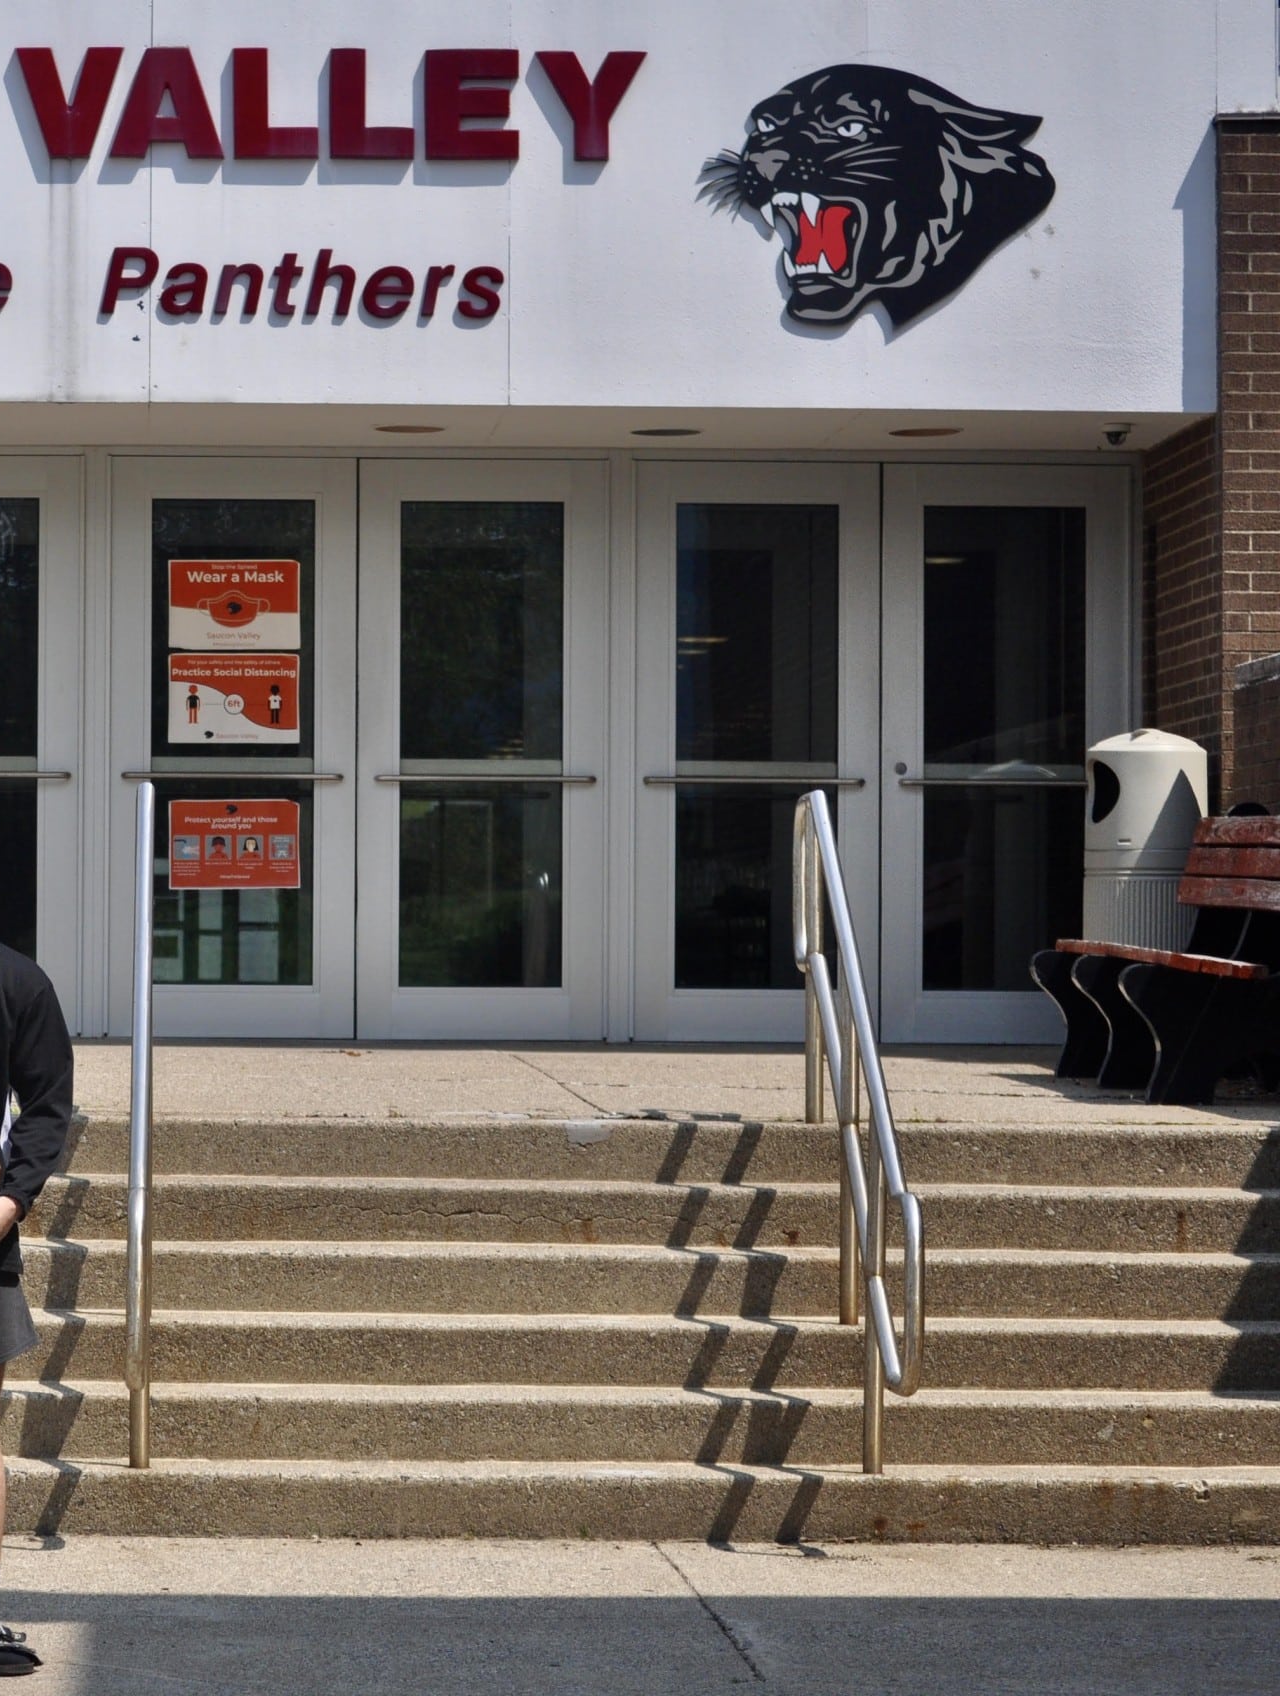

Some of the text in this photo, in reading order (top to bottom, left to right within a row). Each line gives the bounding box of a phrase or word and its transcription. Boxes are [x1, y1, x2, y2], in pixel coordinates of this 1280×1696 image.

[15, 46, 648, 162] VALLEY
[100, 246, 505, 320] Panthers
[187, 570, 284, 583] Wear a Mask
[207, 632, 261, 641] Saucon Valley
[172, 668, 296, 678] Practice Social Distancing
[227, 700, 241, 708] 6ft
[212, 816, 241, 825] yourself
